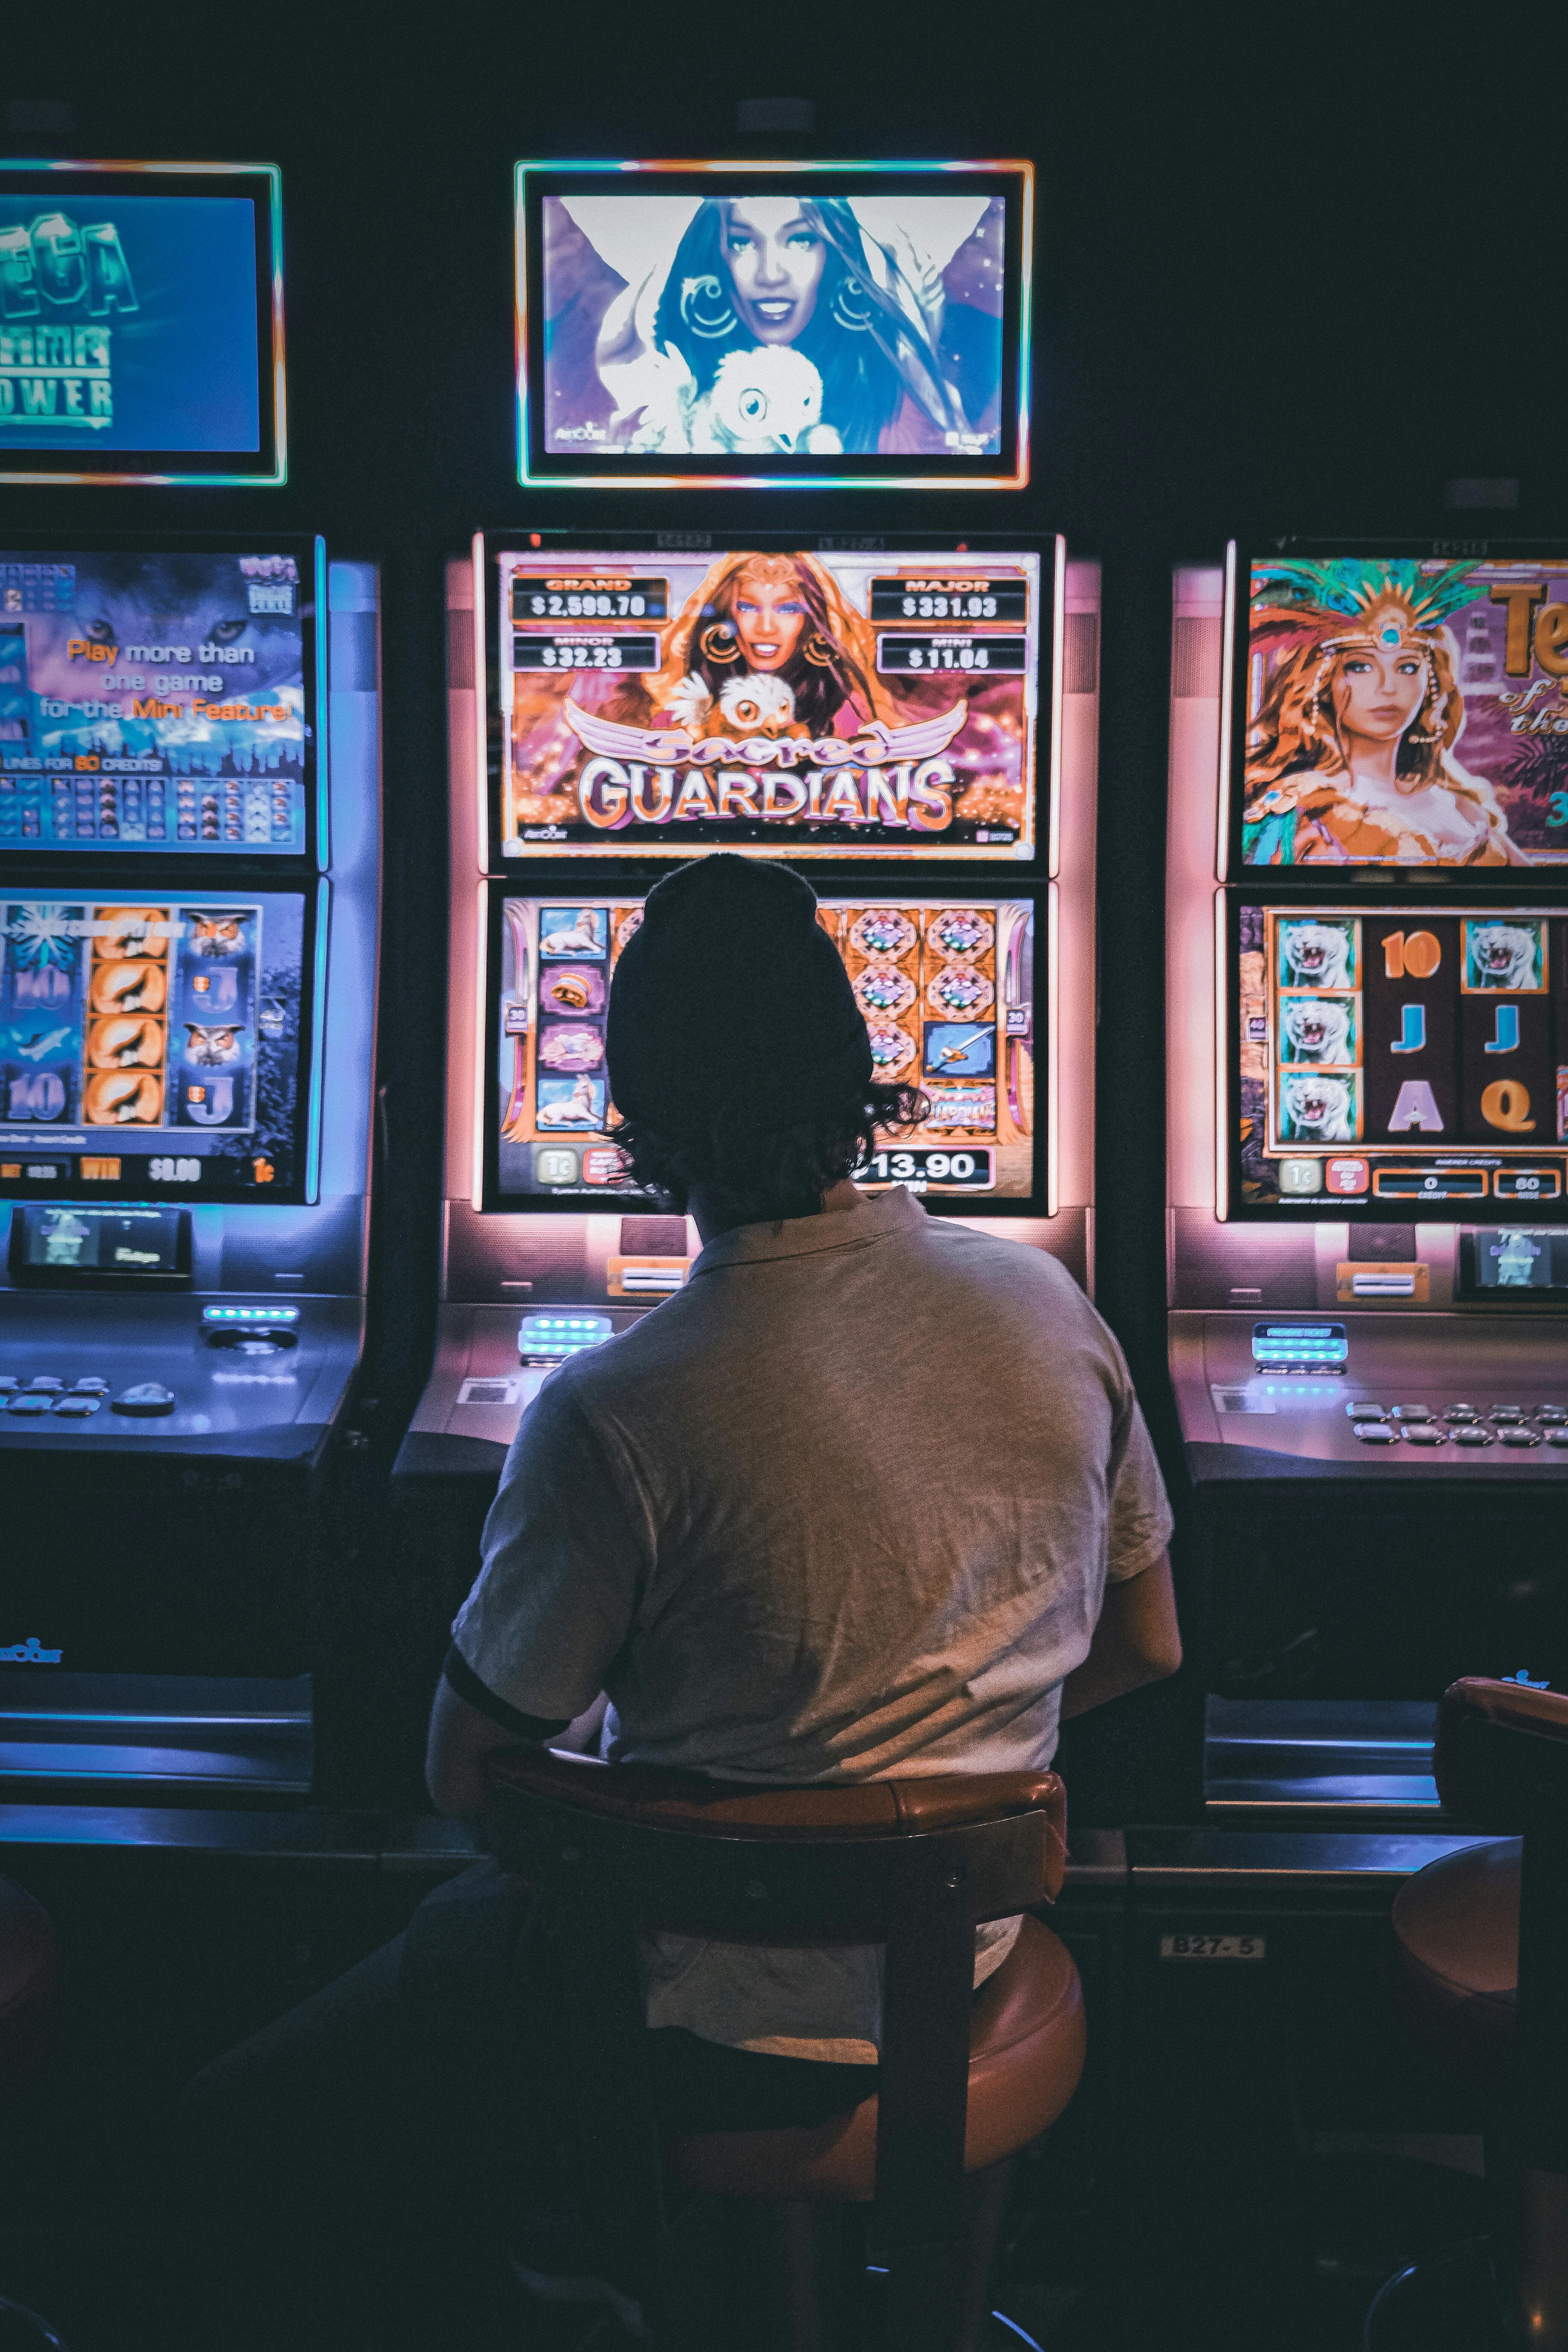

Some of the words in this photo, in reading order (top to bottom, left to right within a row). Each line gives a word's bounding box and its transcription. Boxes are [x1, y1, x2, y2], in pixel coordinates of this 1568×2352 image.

[545, 580, 632, 591] GRAND
[906, 580, 989, 592] MAJOR
[68, 640, 118, 666] Play
[126, 646, 191, 663] more
[199, 642, 255, 663] than
[100, 674, 145, 691] one
[153, 674, 224, 697] game
[1499, 679, 1554, 715] of
[40, 698, 70, 717] for
[83, 699, 122, 717] the
[133, 698, 182, 718] Mini
[192, 698, 292, 721] Feature!
[1511, 707, 1568, 736] the
[579, 758, 956, 830] GUARDIANS
[1381, 930, 1441, 979] 10
[14, 965, 71, 1011] 10
[191, 966, 238, 1014] J
[1390, 1003, 1427, 1055] J
[1484, 1004, 1520, 1055] J
[8, 1073, 66, 1121] 10
[187, 1076, 234, 1125] J
[1387, 1080, 1444, 1132] A
[1481, 1079, 1537, 1132] Q
[1424, 1176, 1438, 1190] 0
